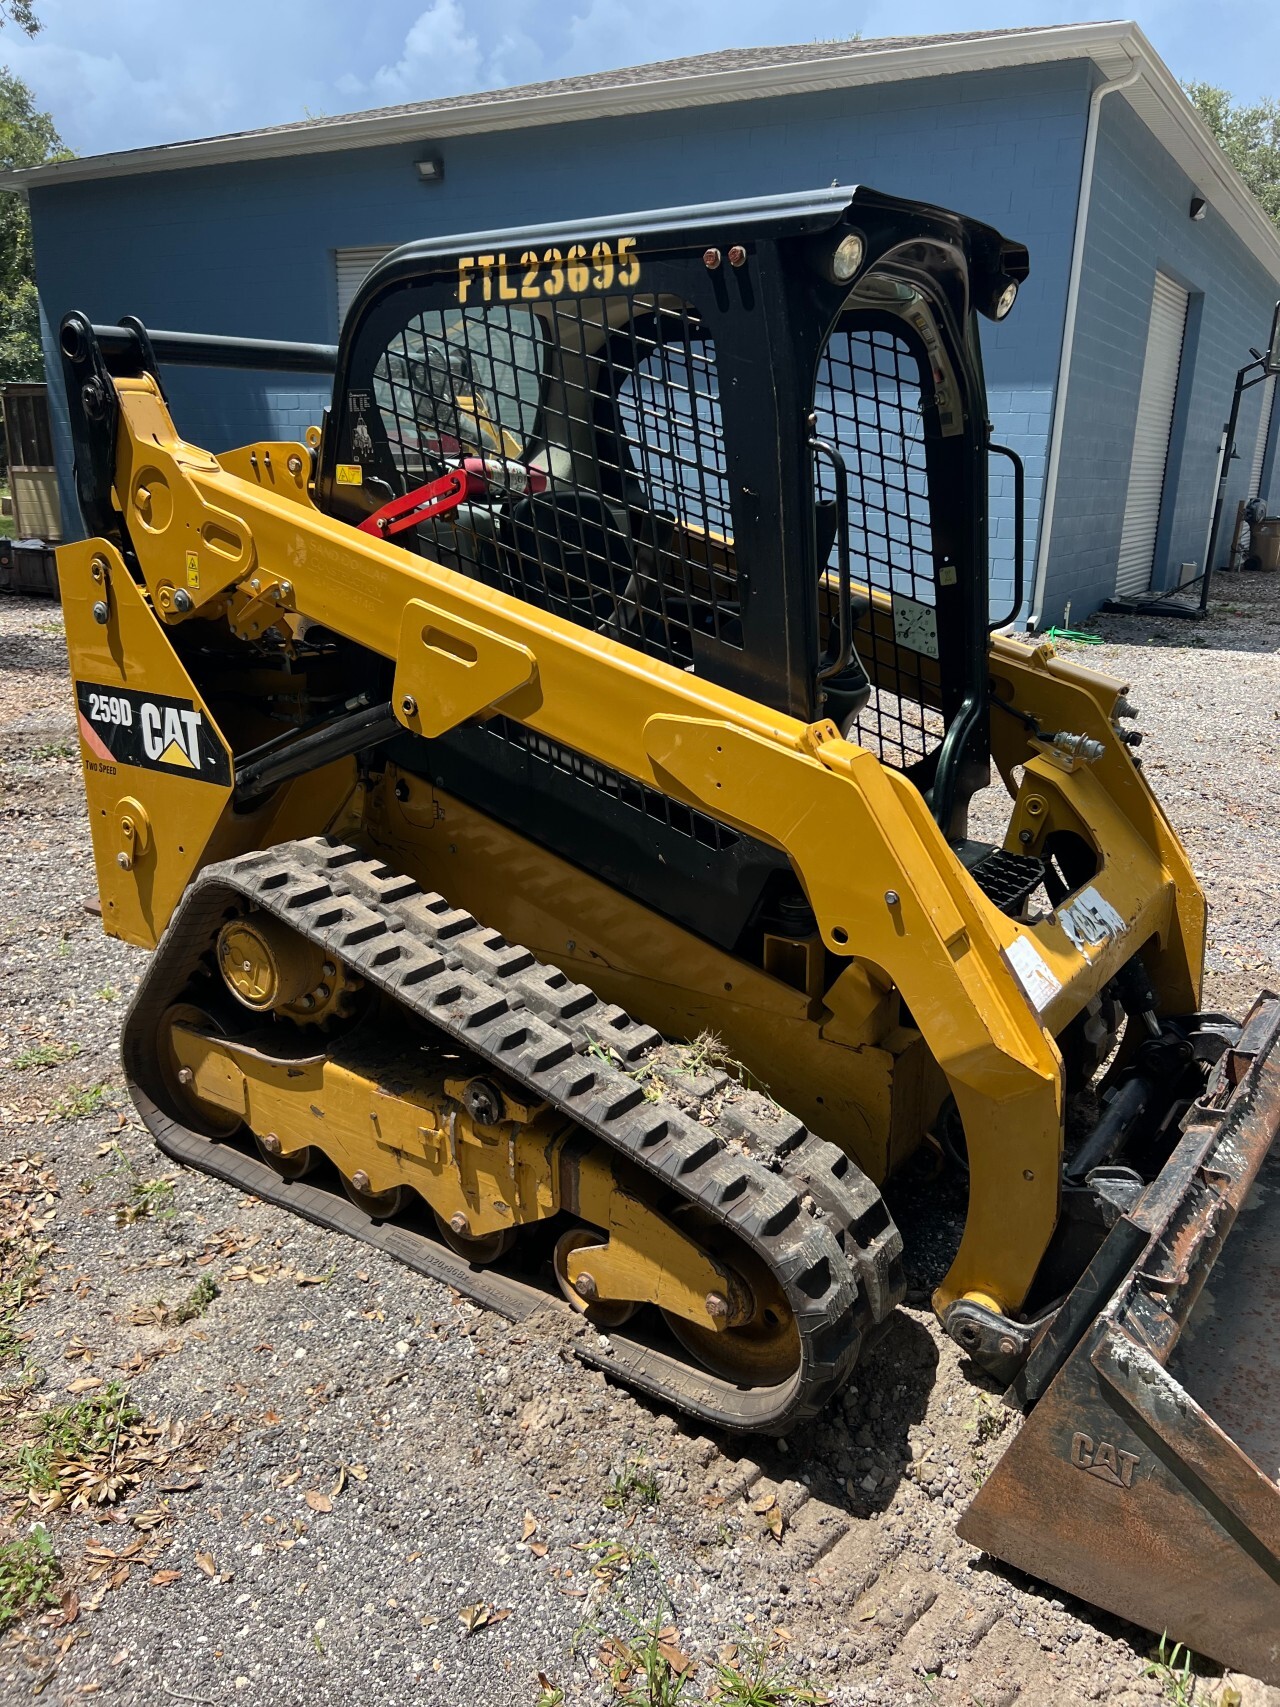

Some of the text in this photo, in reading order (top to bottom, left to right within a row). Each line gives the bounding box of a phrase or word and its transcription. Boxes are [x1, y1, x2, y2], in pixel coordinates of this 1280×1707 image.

[459, 237, 641, 303] FTL23695
[89, 693, 202, 770] 259D CAT
[1071, 1431, 1141, 1490] CAT
